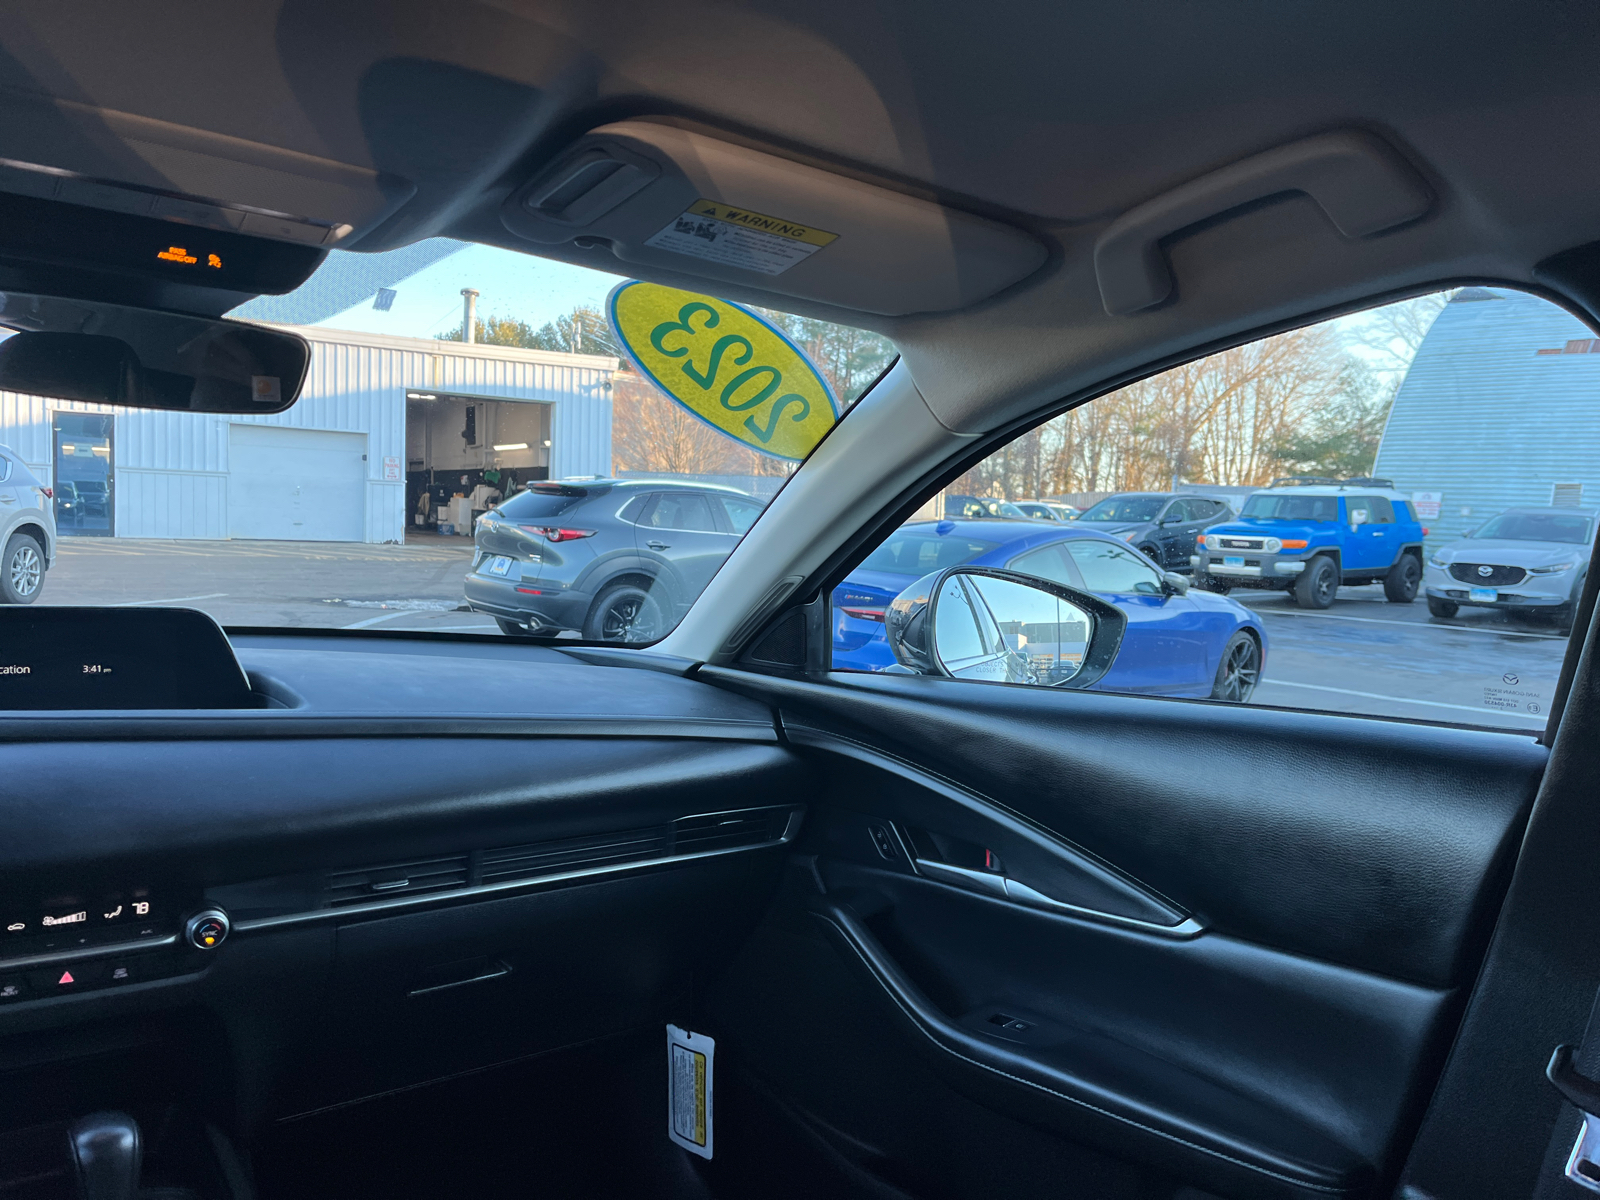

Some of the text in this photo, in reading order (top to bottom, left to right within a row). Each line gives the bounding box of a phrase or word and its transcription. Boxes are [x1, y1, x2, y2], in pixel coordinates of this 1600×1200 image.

[725, 210, 806, 237] WARNING
[169, 247, 187, 256] PASS
[82, 664, 102, 673] 3:41
[132, 902, 149, 915] 78
[202, 930, 218, 938] SYNC
